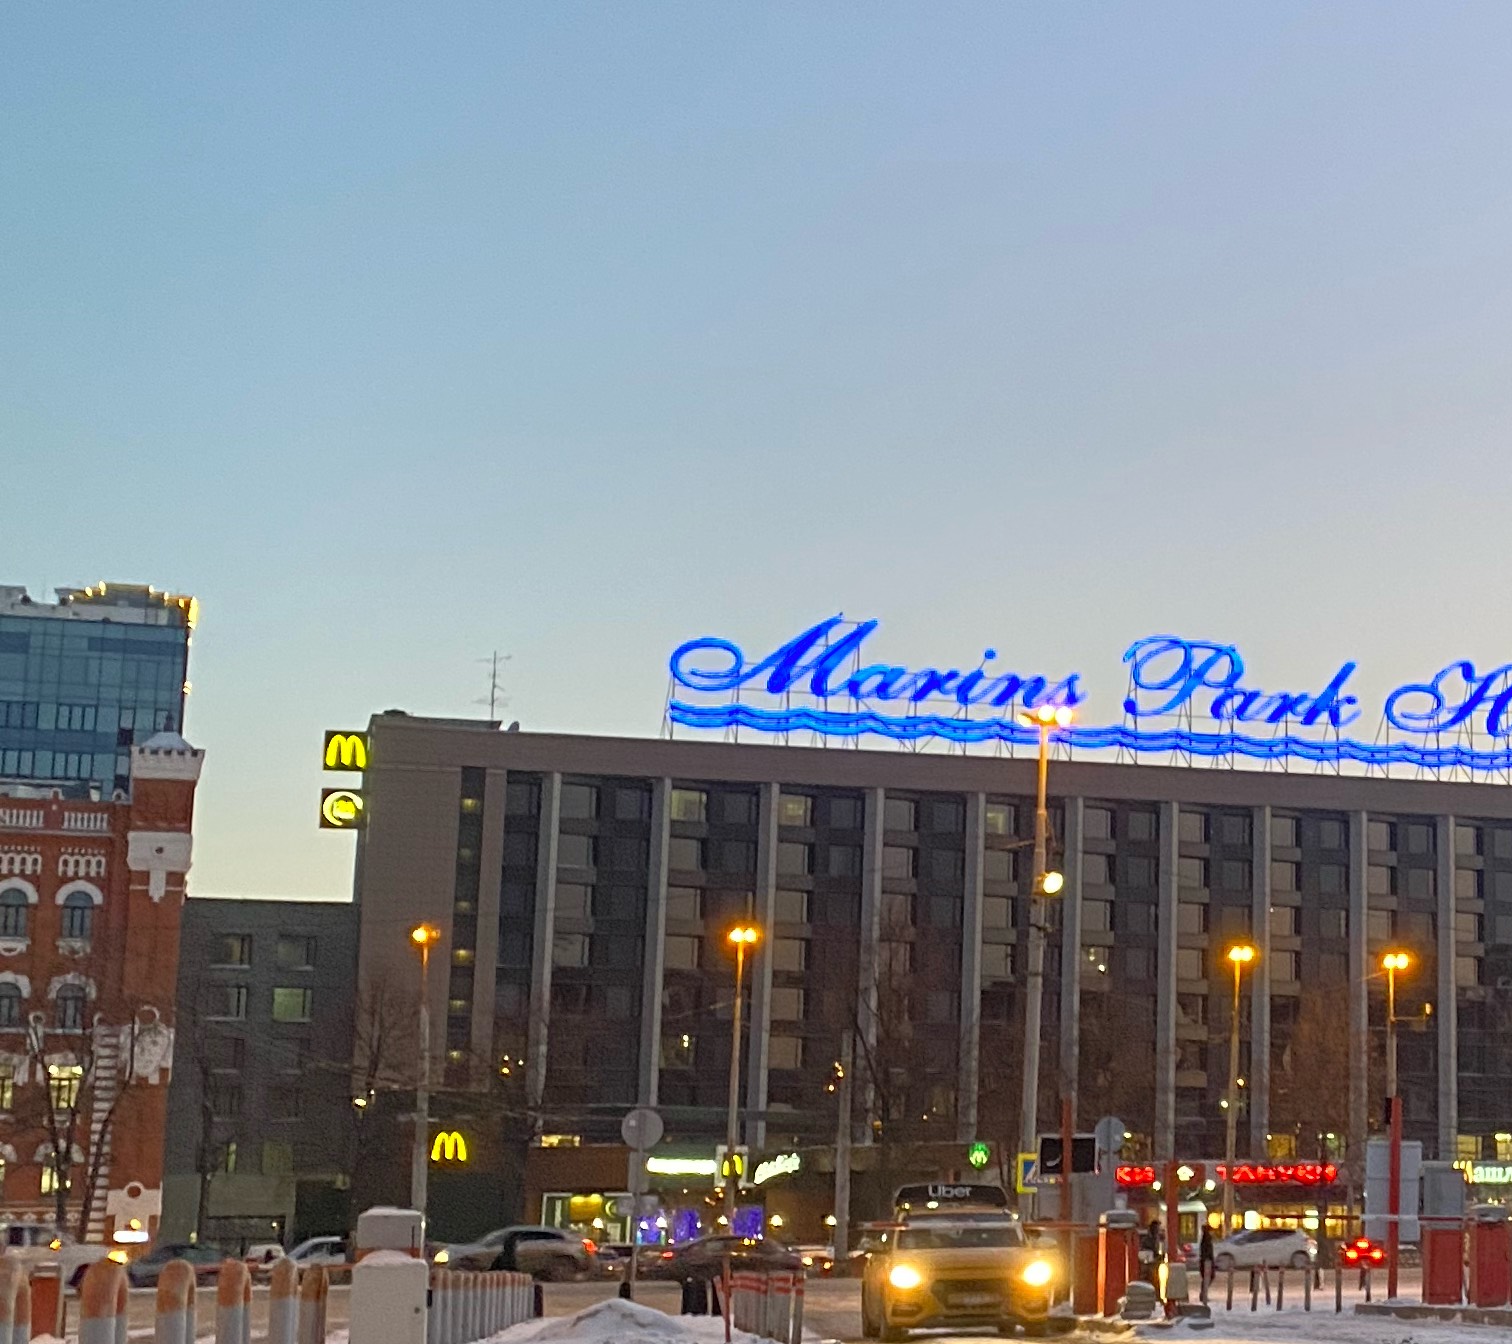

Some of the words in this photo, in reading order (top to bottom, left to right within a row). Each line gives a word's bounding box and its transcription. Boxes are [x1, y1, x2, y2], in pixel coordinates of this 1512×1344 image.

[669, 611, 1086, 710] Marins
[1122, 633, 1362, 728] Park
[928, 1183, 973, 1199] Uber
